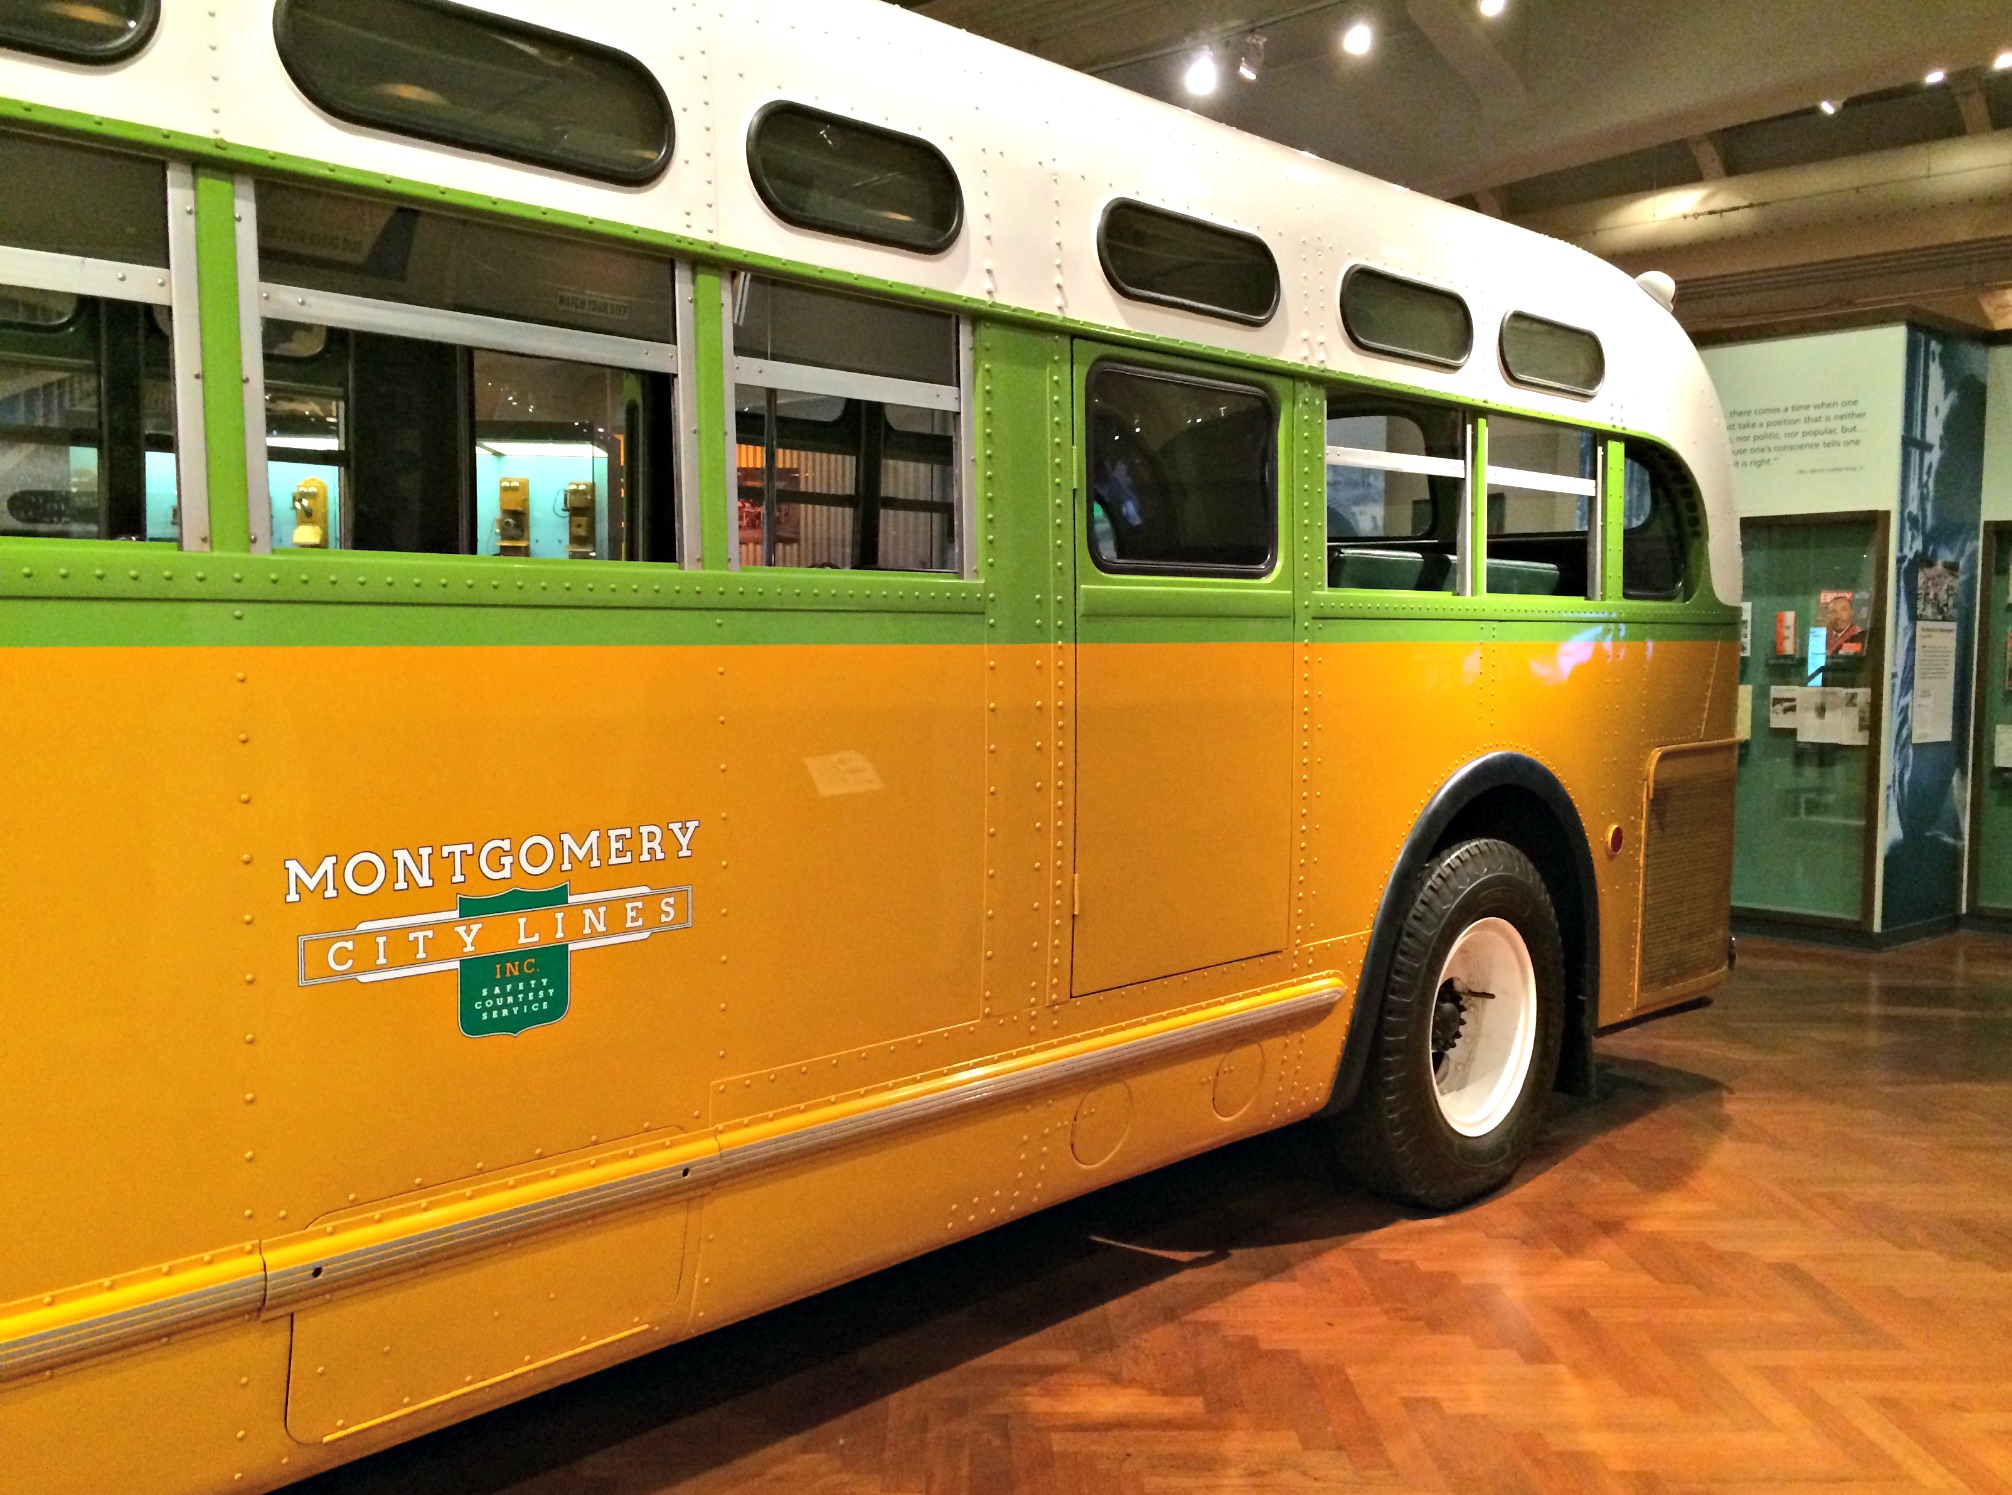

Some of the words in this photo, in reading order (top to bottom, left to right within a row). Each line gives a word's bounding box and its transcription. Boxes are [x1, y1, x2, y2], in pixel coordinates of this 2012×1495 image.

[1754, 406, 1781, 416] comes
[1791, 403, 1811, 413] time
[1813, 400, 1839, 410] when
[1840, 399, 1859, 408] one
[1738, 420, 1757, 430] take
[1766, 416, 1801, 429] position
[1804, 415, 1823, 424] that
[1833, 411, 1867, 421] neither
[1736, 435, 1750, 443] nor
[1784, 430, 1799, 439] nor
[1749, 445, 1771, 454] one's
[1773, 442, 1821, 452] conscience
[1822, 439, 1841, 448] tells
[1843, 439, 1861, 447] one
[1733, 460, 1741, 468] it
[1742, 459, 1748, 468] is
[284, 820, 700, 903] MONTGOMERY
[327, 923, 483, 972] CITY
[517, 896, 676, 945] LINES
[495, 958, 541, 979] INC.
[482, 978, 548, 997] SAFETY
[474, 989, 555, 1010] COURTESY
[482, 1001, 548, 1020] SERVICE
